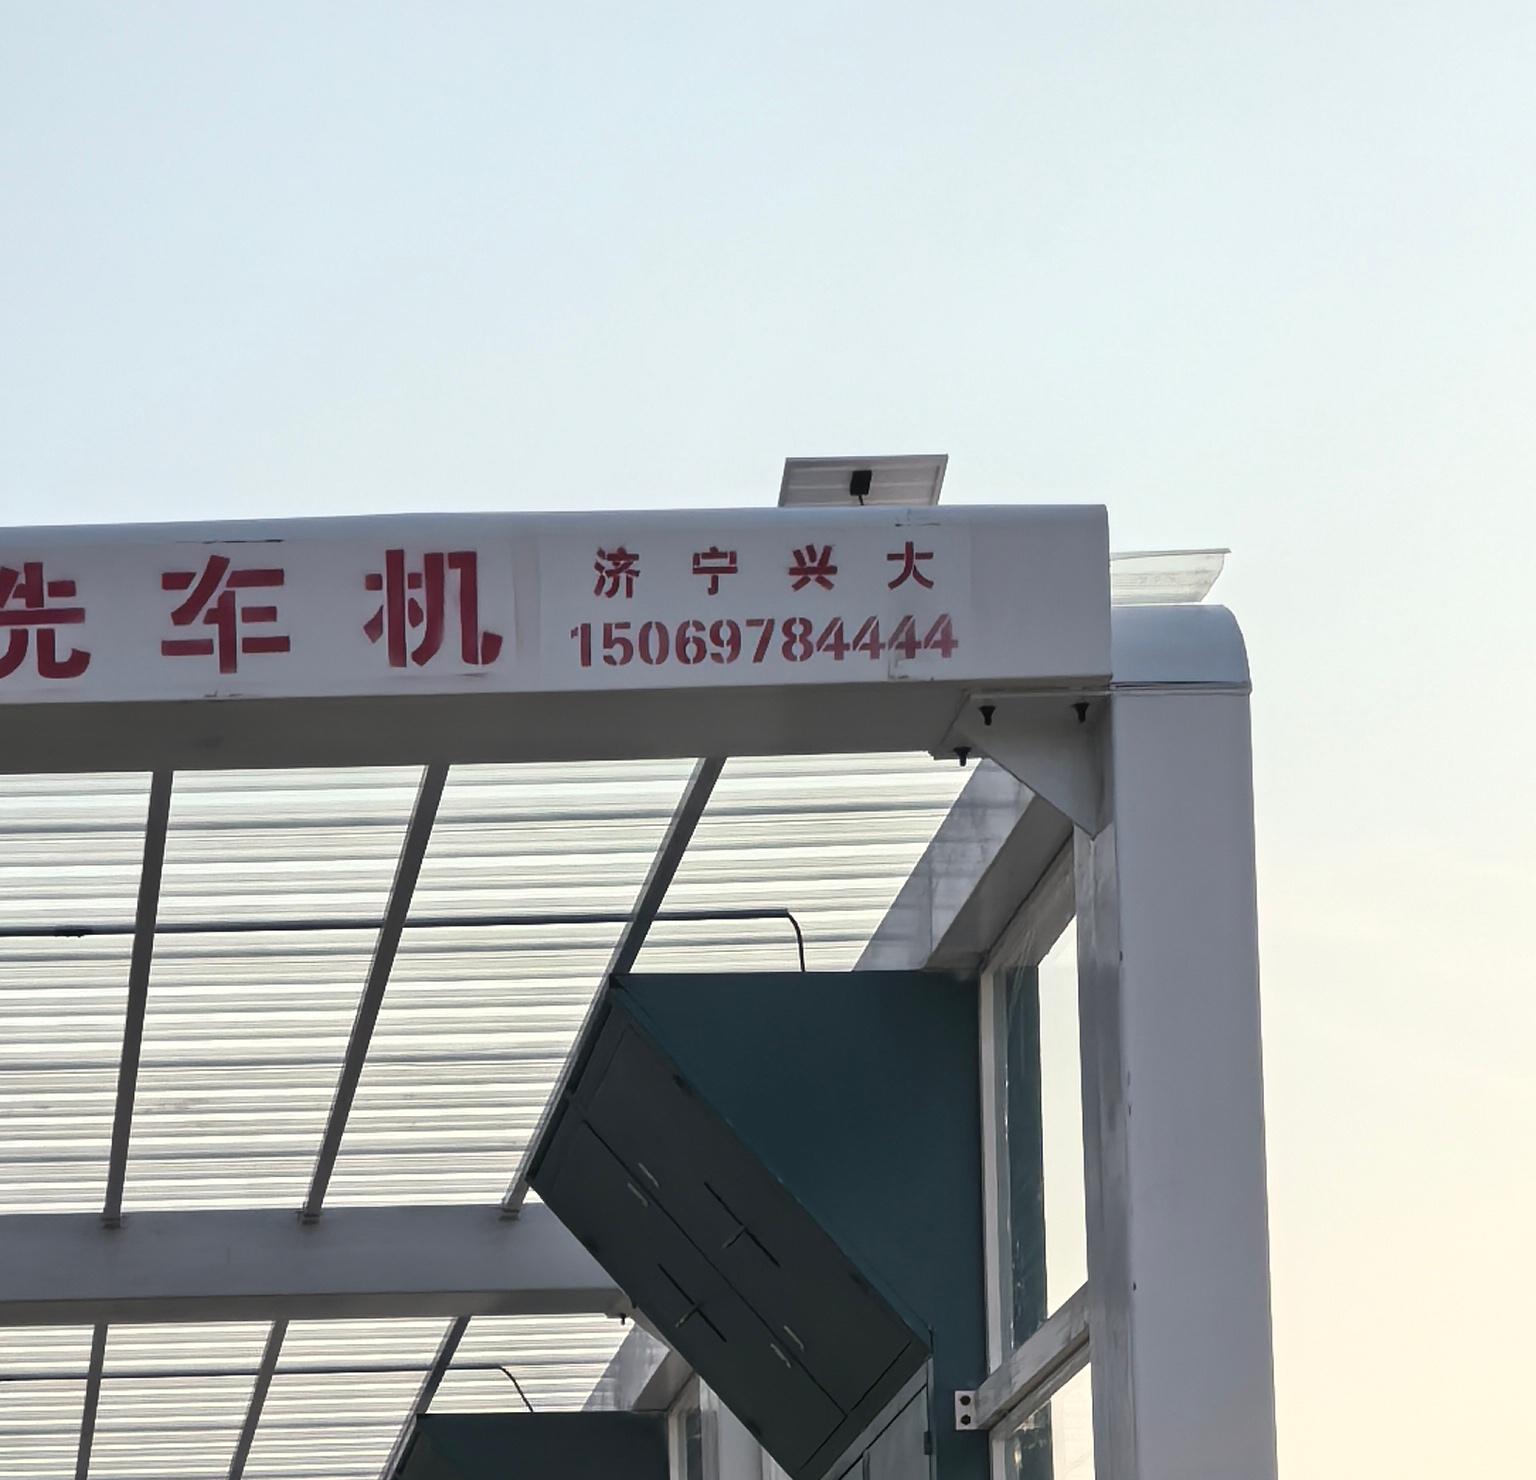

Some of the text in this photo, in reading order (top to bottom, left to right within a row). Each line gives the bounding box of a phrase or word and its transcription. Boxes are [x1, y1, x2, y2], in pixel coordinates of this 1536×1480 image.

[593, 541, 934, 599] 济宁兴大
[570, 613, 959, 667] 15069784444
